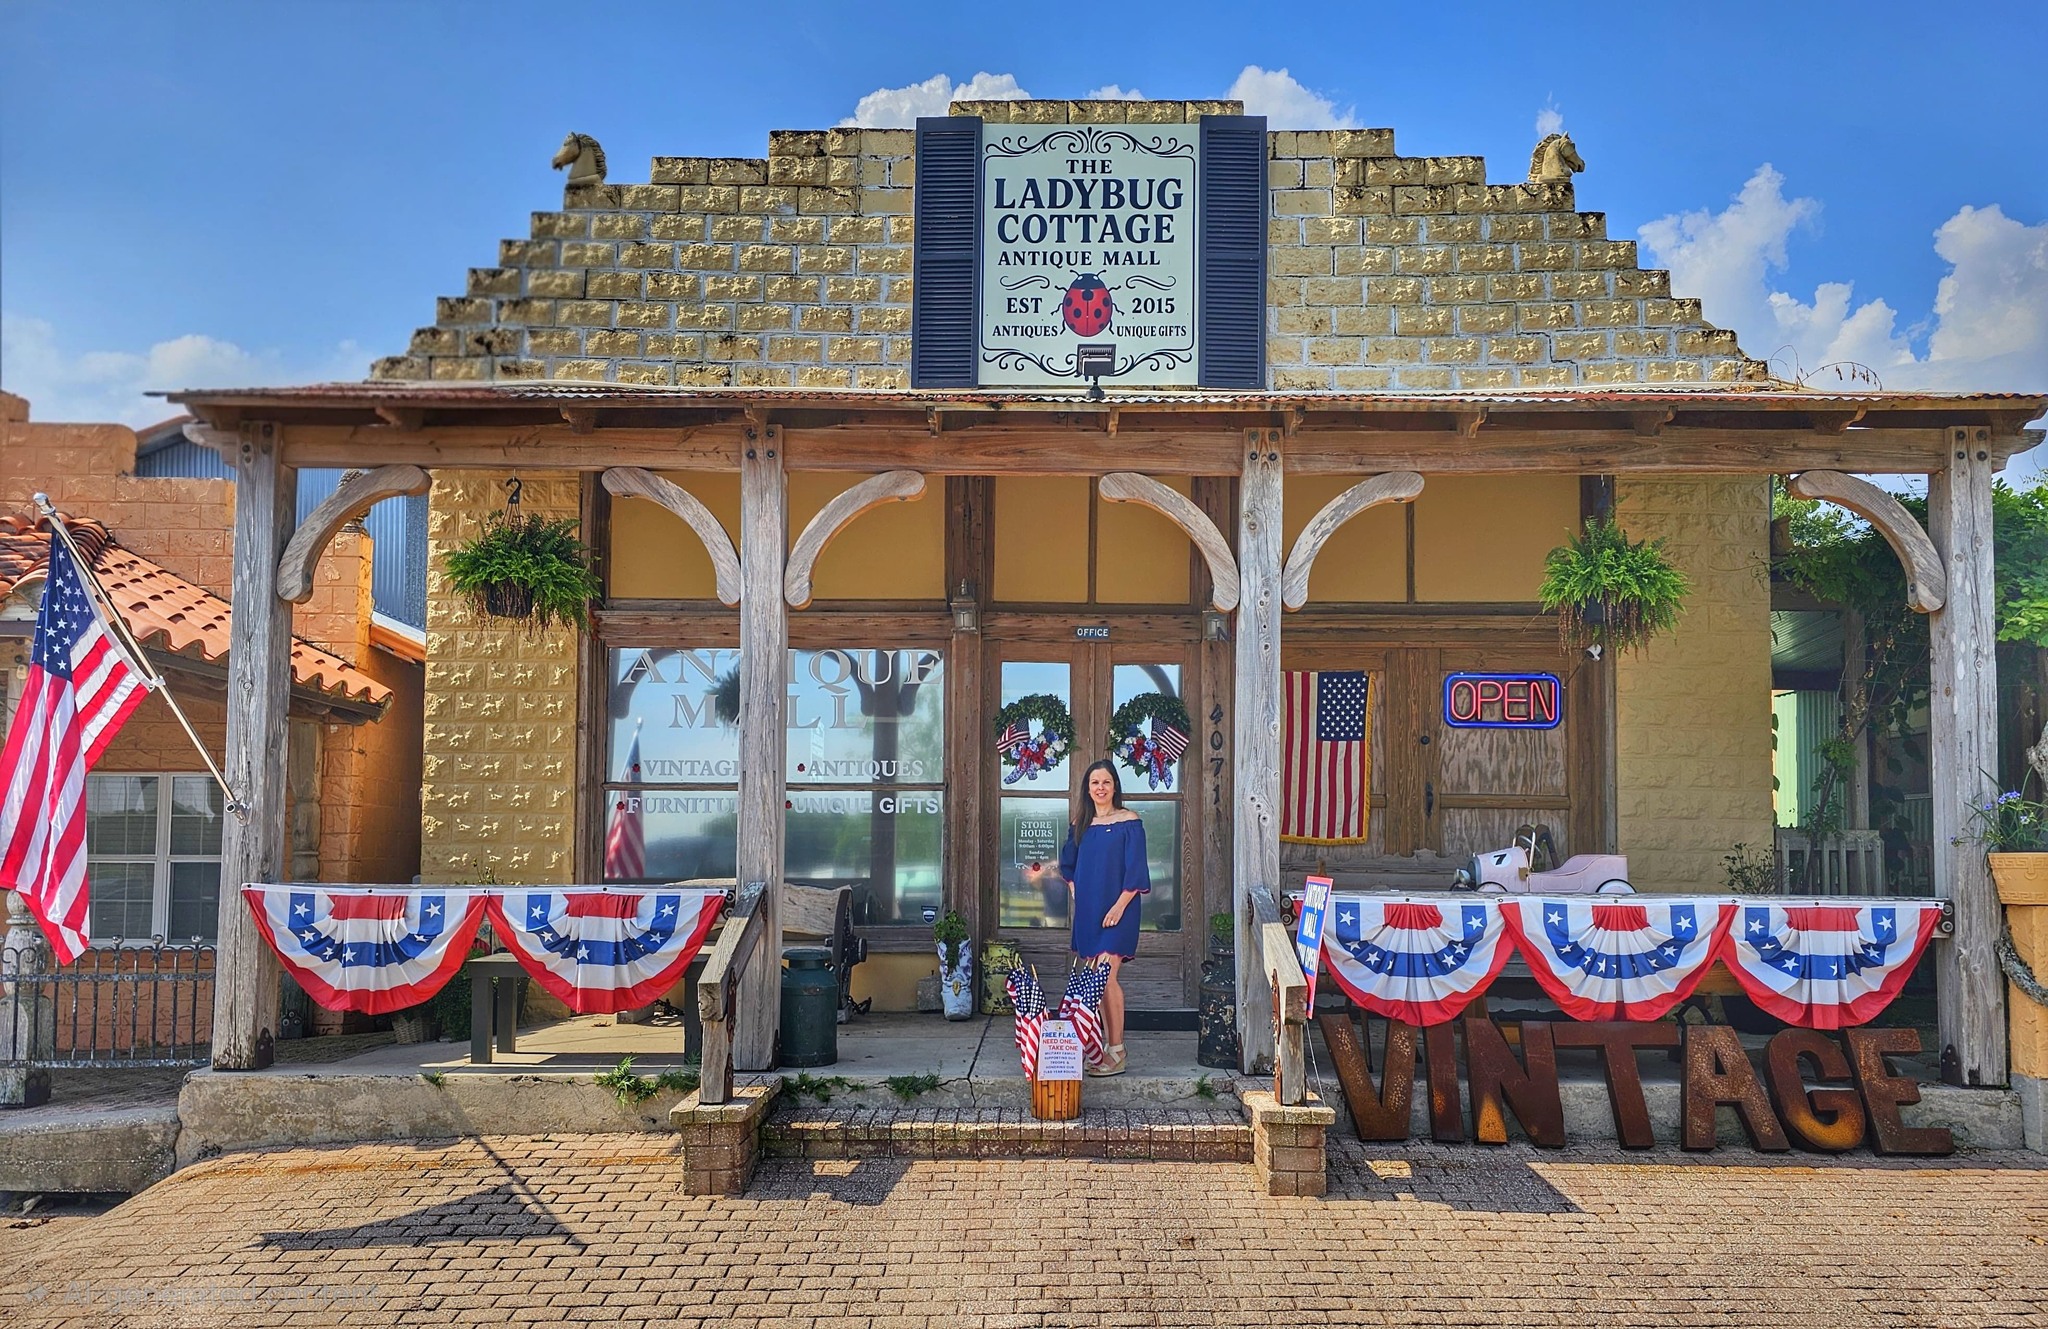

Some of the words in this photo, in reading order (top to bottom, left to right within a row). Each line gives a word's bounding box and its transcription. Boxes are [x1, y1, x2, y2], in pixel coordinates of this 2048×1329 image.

[1065, 159, 1113, 174] THE
[993, 178, 1184, 210] LADYBUG
[997, 213, 1175, 244] COTTAGE
[998, 250, 1092, 269] ANTIQUE
[1102, 250, 1161, 266] MALL
[1006, 297, 1043, 314] EST
[1132, 297, 1175, 314] 2015
[992, 325, 1058, 338] ANTIQUES
[1116, 325, 1157, 338] UNIQUE
[1158, 325, 1187, 337] GIFTS
[1077, 628, 1109, 637] OFFICE
[620, 648, 943, 694] ANIQUE
[1451, 680, 1556, 722] OPEN
[668, 694, 868, 729] MLL
[807, 760, 924, 780] ANTIQUES
[794, 797, 873, 815] UNIQUE
[879, 797, 939, 814] GIFTS
[1020, 829, 1053, 838] HOURS
[1021, 821, 1052, 829] STORE
[1493, 853, 1507, 866] 7
[1318, 1013, 1954, 1157] VINTAGE
